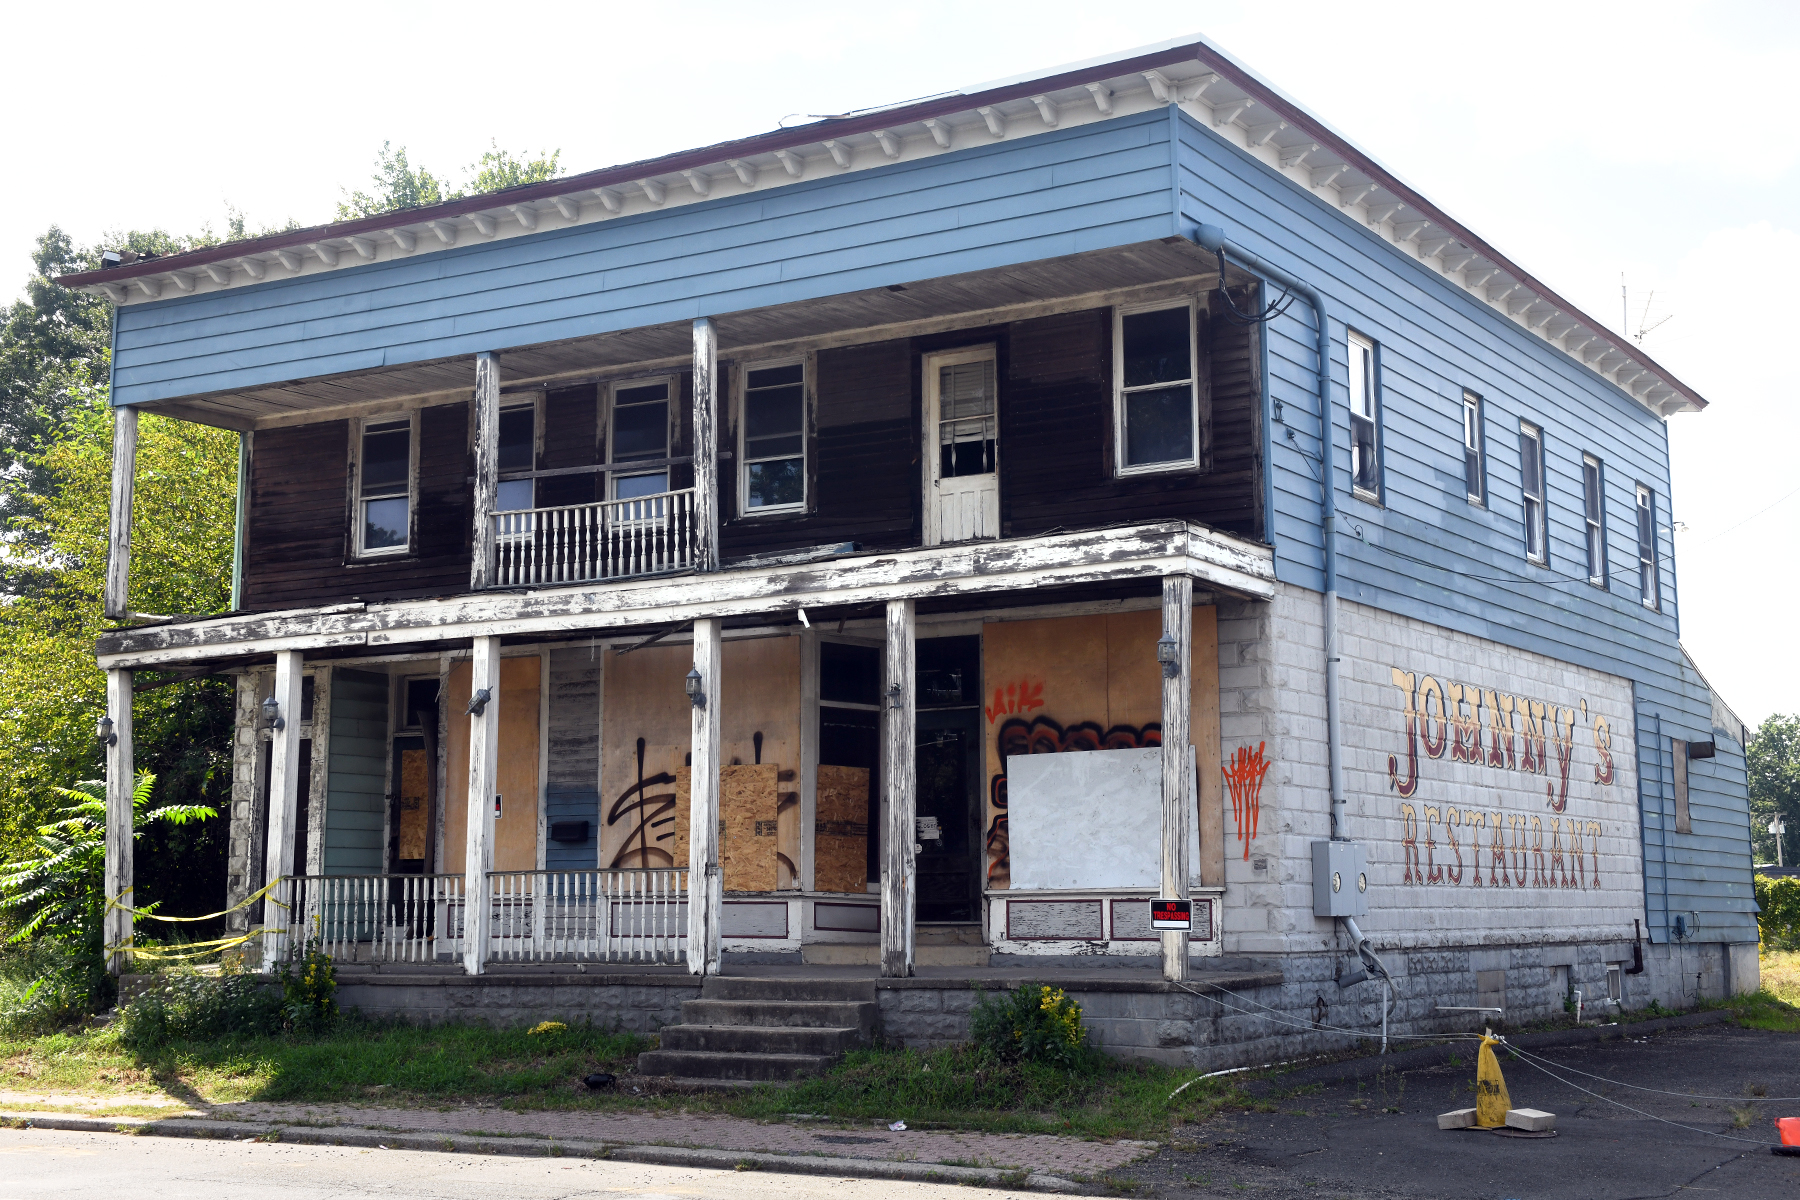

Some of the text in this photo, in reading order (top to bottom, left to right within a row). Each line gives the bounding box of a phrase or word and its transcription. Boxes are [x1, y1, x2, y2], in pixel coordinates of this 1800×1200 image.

[1388, 667, 1614, 814] JOHNNY'S
[1401, 803, 1602, 891] RESTAURANT
[1153, 911, 1190, 921] TRESPASSING
[1166, 902, 1177, 911] NO
